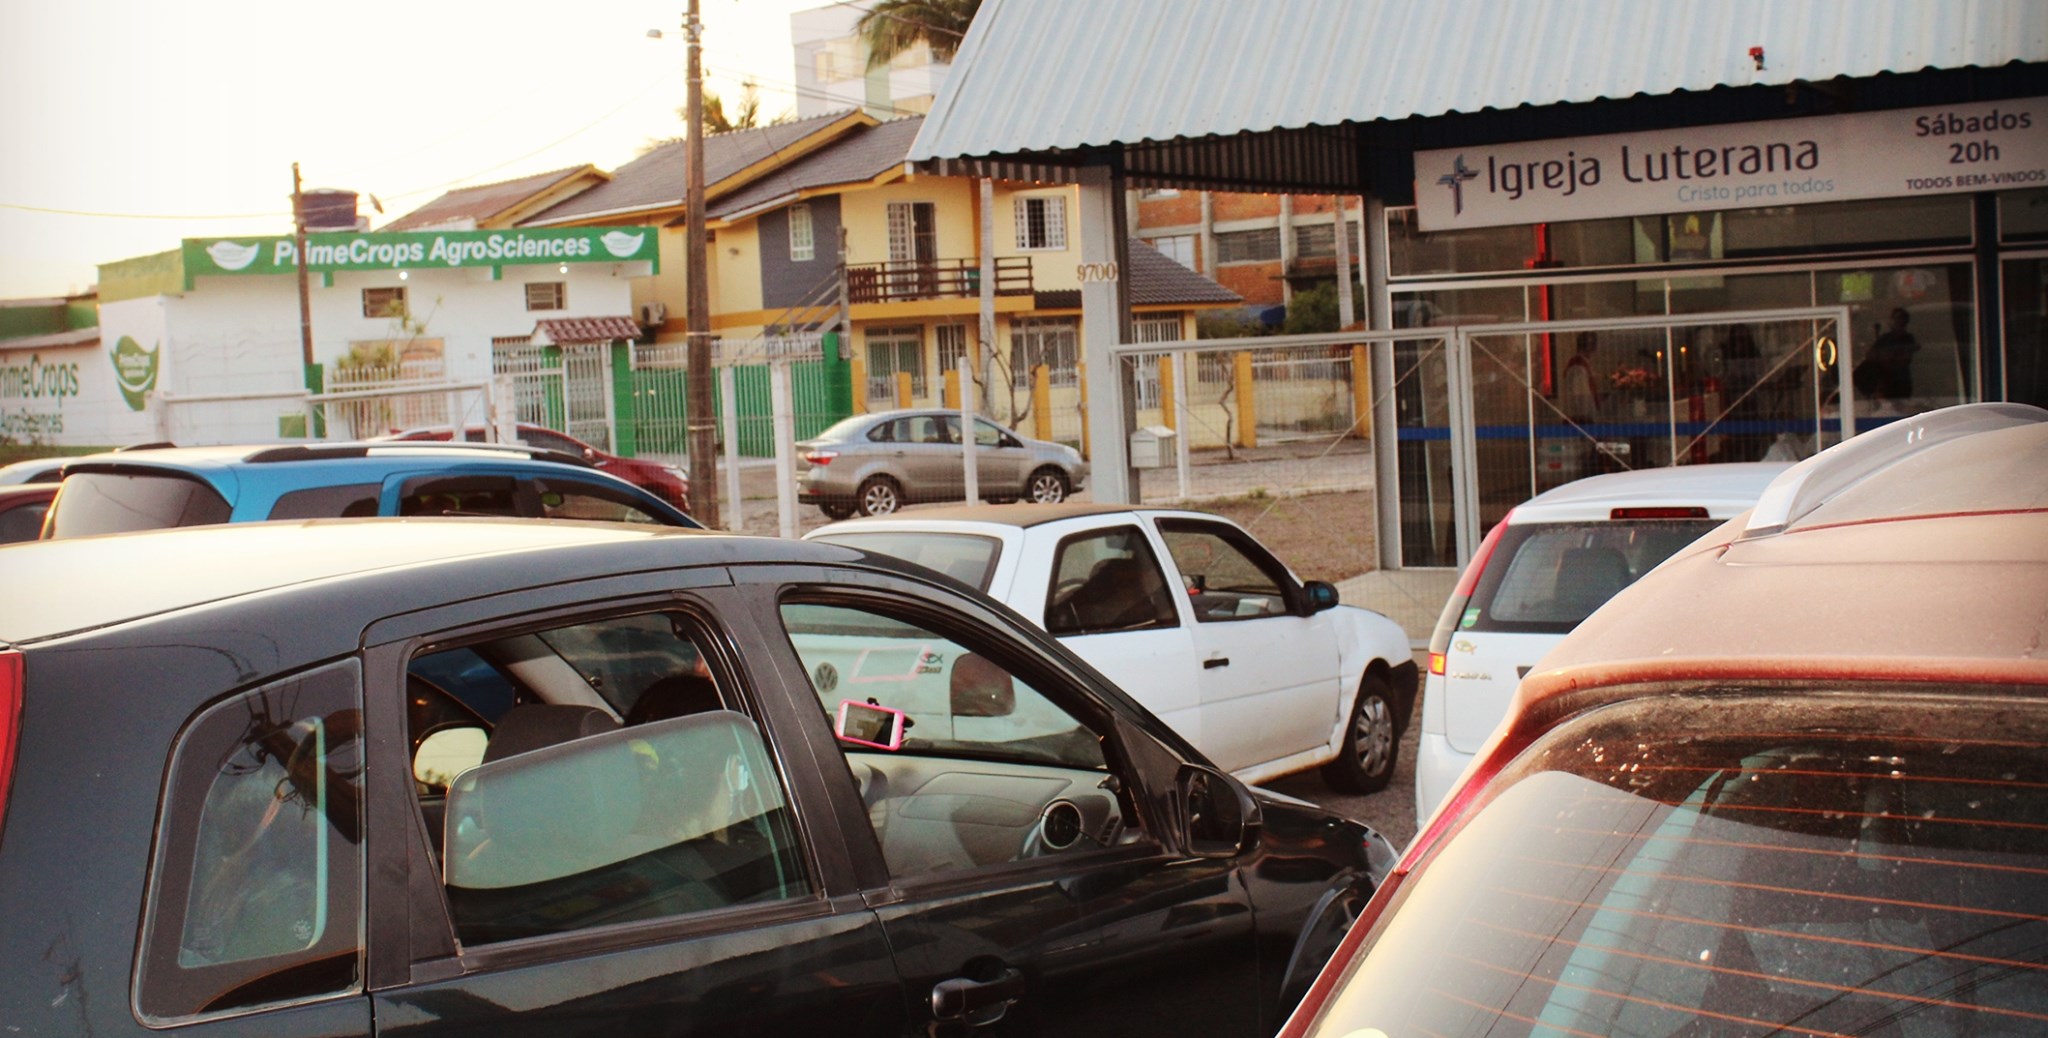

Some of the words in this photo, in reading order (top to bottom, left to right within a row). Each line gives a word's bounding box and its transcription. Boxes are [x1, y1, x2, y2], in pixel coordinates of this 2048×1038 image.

[1915, 109, 2032, 137] Sábados
[1949, 140, 2000, 164] 20h
[1488, 151, 1600, 200] Igreja
[1621, 139, 1820, 183] Luterana
[1906, 176, 1953, 190] TODOS
[1956, 168, 2047, 186] BEM-VINDOS
[1677, 183, 1731, 203] Cristo
[1735, 182, 1777, 202] para
[1783, 176, 1835, 195] todos
[428, 234, 591, 266] AgroSciences
[1077, 262, 1116, 282] 9700
[0, 353, 78, 408] rimeCrops
